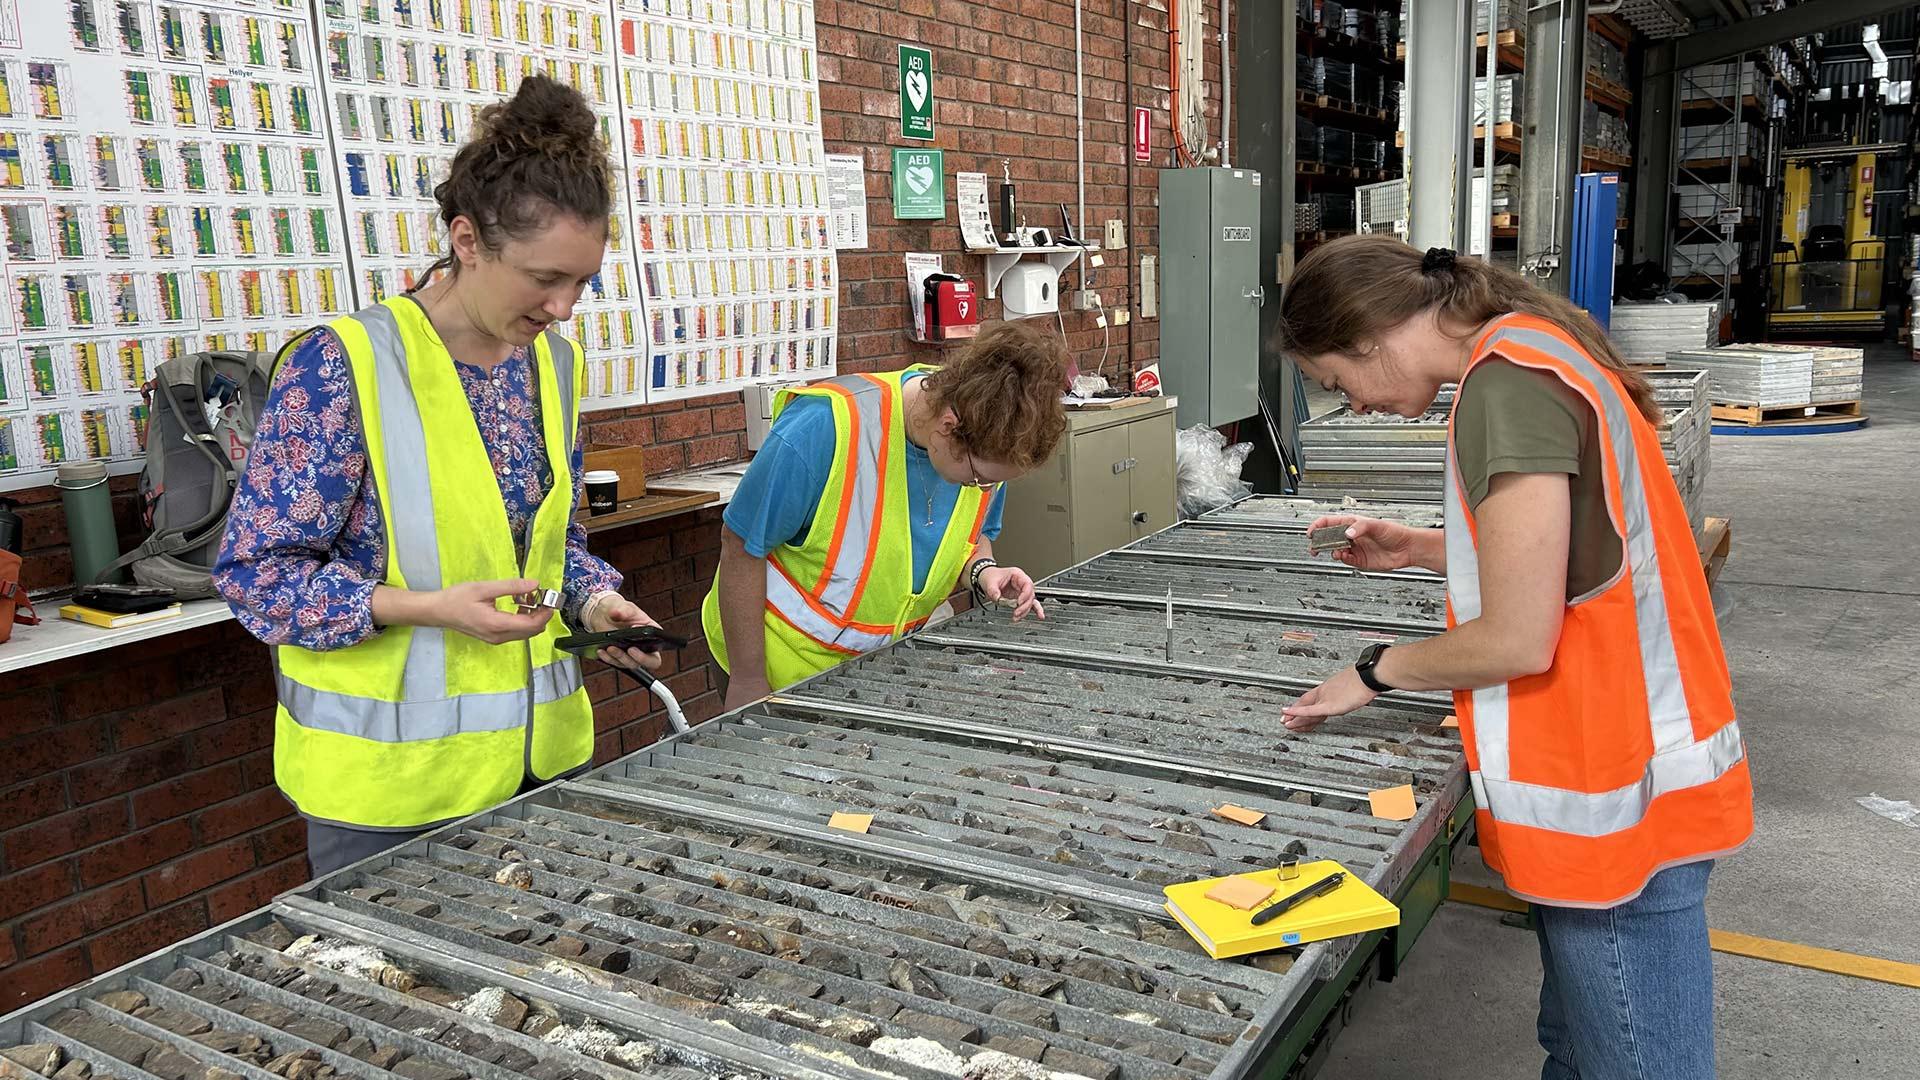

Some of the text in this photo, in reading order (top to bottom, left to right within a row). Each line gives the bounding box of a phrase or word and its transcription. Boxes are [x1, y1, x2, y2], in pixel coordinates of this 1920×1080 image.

[329, 21, 355, 30] Avebury
[908, 55, 923, 70] AED
[229, 68, 253, 77] Hellyer
[908, 155, 930, 165] AED
[1224, 228, 1250, 239] SWITCHBOARD
